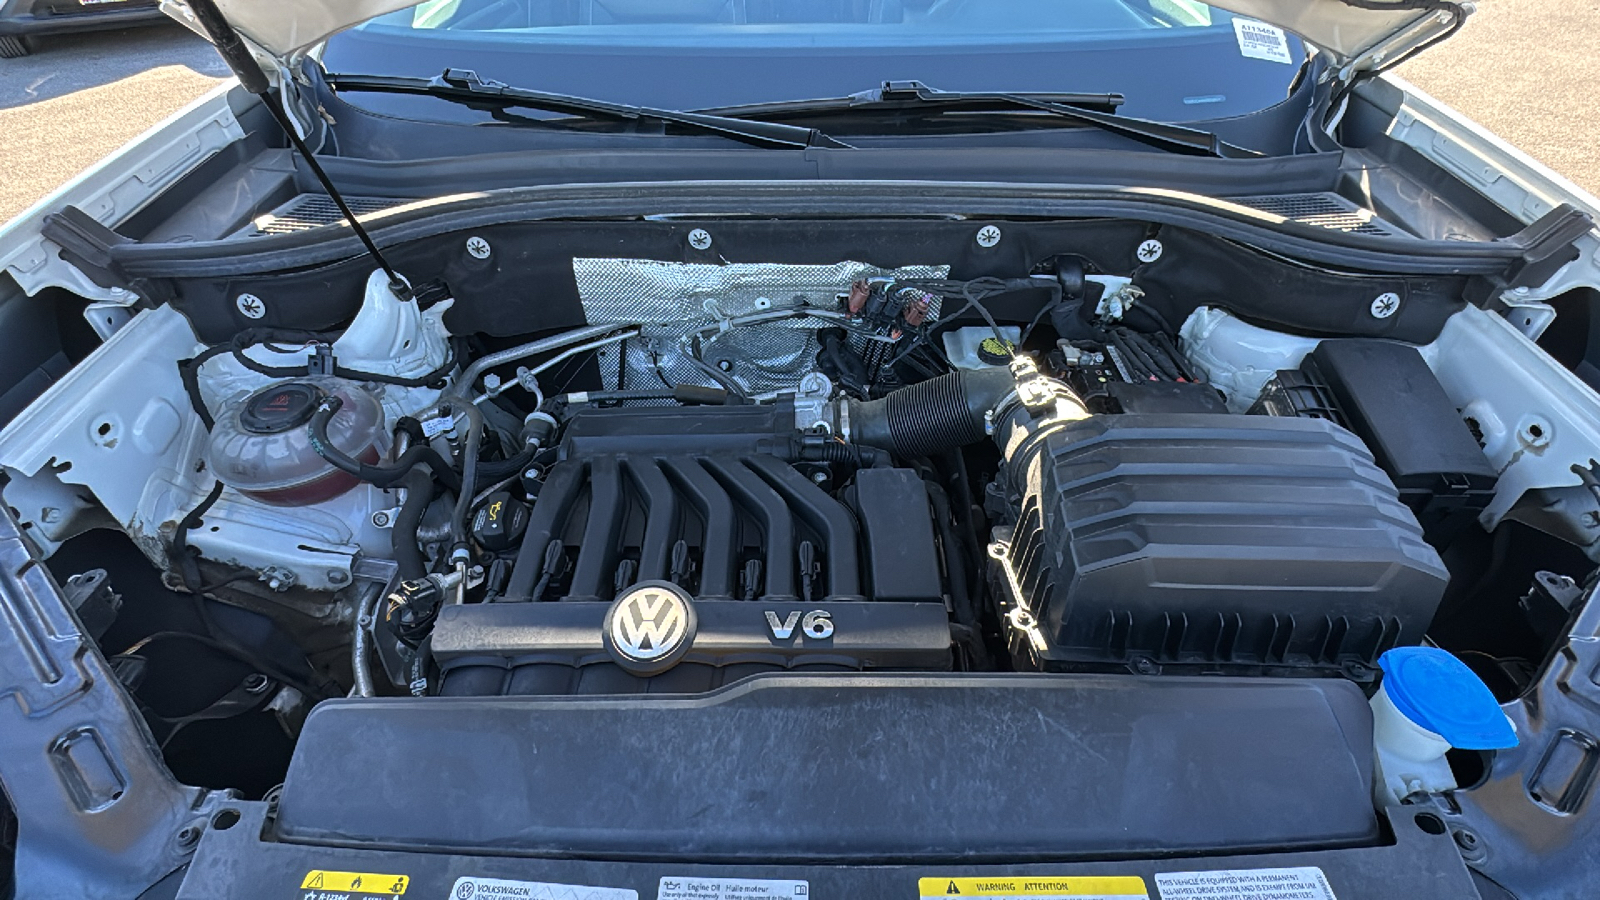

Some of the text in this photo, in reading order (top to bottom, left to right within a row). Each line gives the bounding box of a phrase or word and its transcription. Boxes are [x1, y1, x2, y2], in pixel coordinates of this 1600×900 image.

[764, 609, 835, 640] V6
[1174, 878, 1200, 886] VEHICLE
[1207, 876, 1237, 885] EQUIPPED
[1262, 874, 1299, 882] PERMANENT
[477, 884, 531, 896] VOLKSWAGEN
[687, 883, 709, 892] Engine
[744, 885, 769, 893] moteur
[976, 883, 1069, 891] WARNING ATTENTION
[1163, 888, 1196, 896] ALL-WHEEL
[1197, 886, 1216, 894] DRIVE
[1242, 884, 1255, 892] AND
[1262, 883, 1286, 891] EXEMPT
